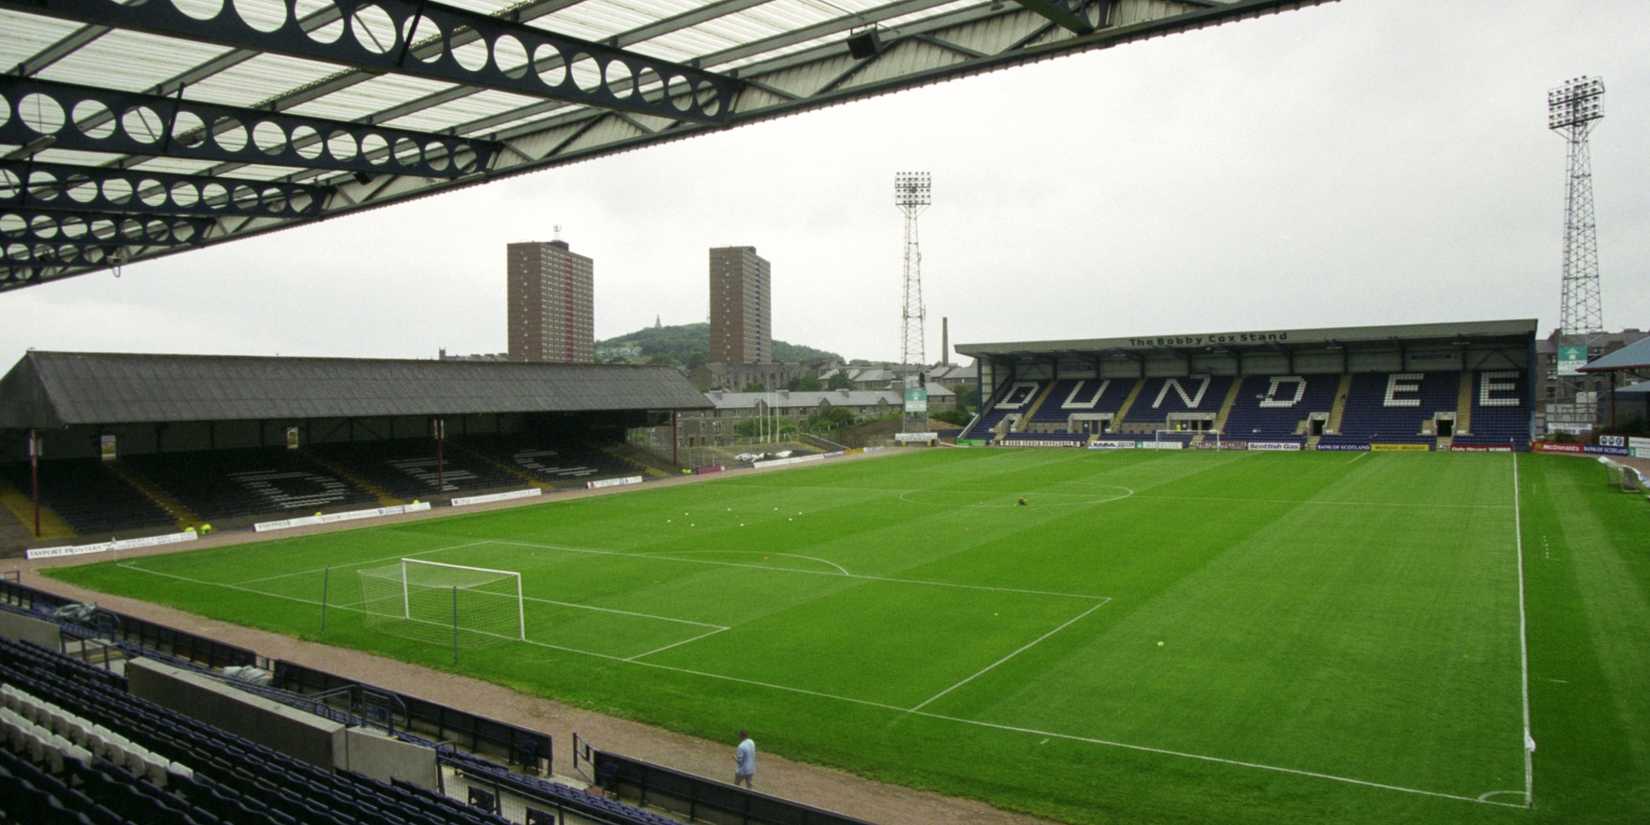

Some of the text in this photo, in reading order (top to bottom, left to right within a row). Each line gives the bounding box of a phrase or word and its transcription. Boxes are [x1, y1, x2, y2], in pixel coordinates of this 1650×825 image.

[1129, 332, 1288, 346] The Bobby Cox Stand
[995, 371, 1520, 408] DUNDEE
